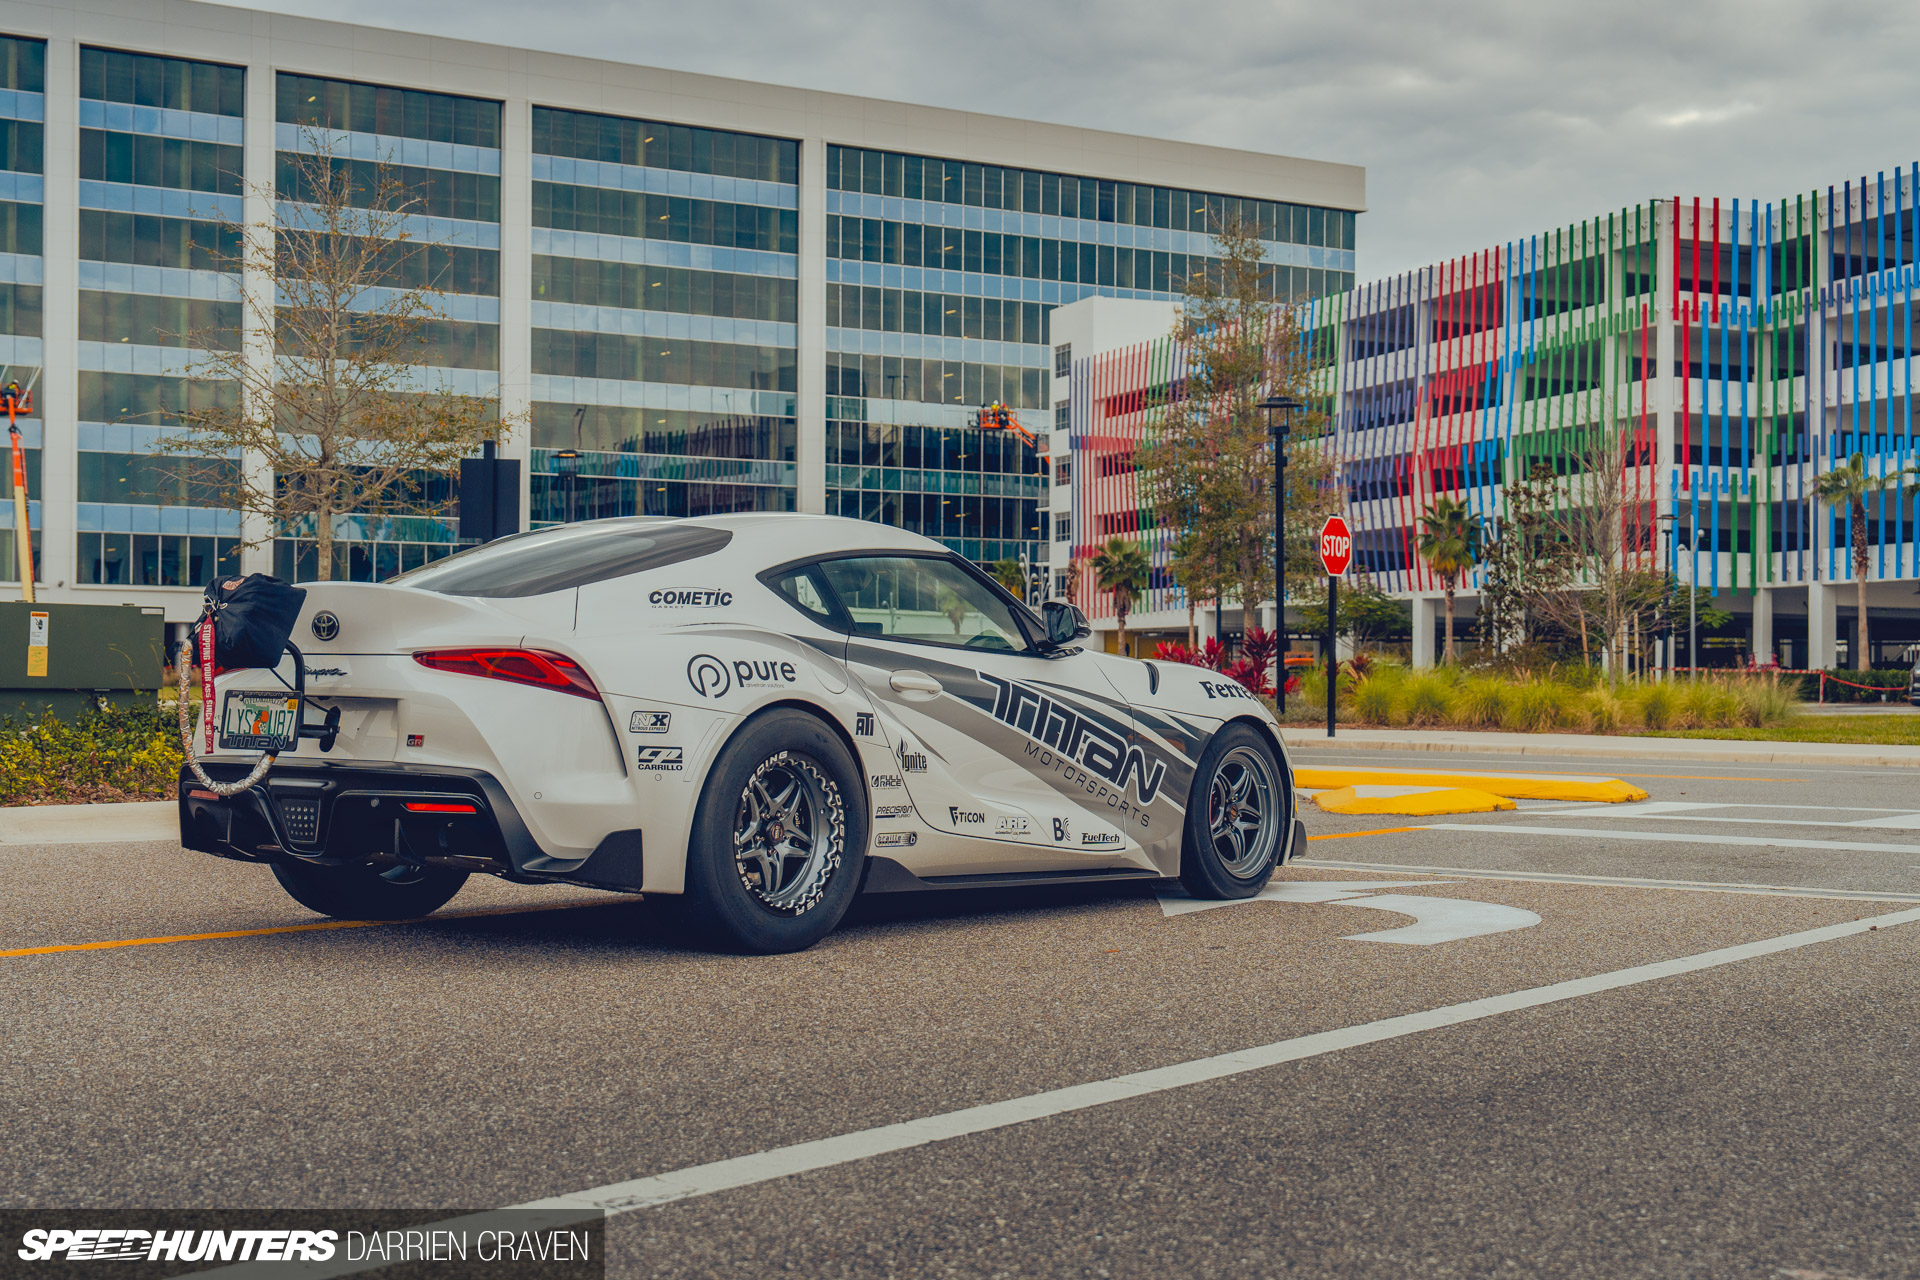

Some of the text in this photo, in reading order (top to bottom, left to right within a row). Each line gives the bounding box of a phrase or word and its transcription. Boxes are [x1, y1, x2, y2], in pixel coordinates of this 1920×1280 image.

[1323, 535, 1349, 558] STOP
[649, 588, 733, 606] COMETIC
[202, 624, 212, 660] STOPPING
[203, 662, 212, 682] YOUR
[732, 660, 797, 688] pure
[204, 683, 212, 698] ASS
[226, 708, 253, 735] LYS
[632, 713, 669, 726] NX
[855, 711, 875, 736] ATI
[407, 737, 423, 746] GR
[741, 750, 788, 802] RACING
[1023, 740, 1151, 828] MOTORSPORTS
[876, 805, 913, 814] PRECISION
[829, 780, 845, 869] FORGED
[995, 815, 1029, 830] ARP
[1081, 832, 1120, 843] FuelTech
[734, 831, 752, 890] WELD
[796, 890, 823, 916] USA
